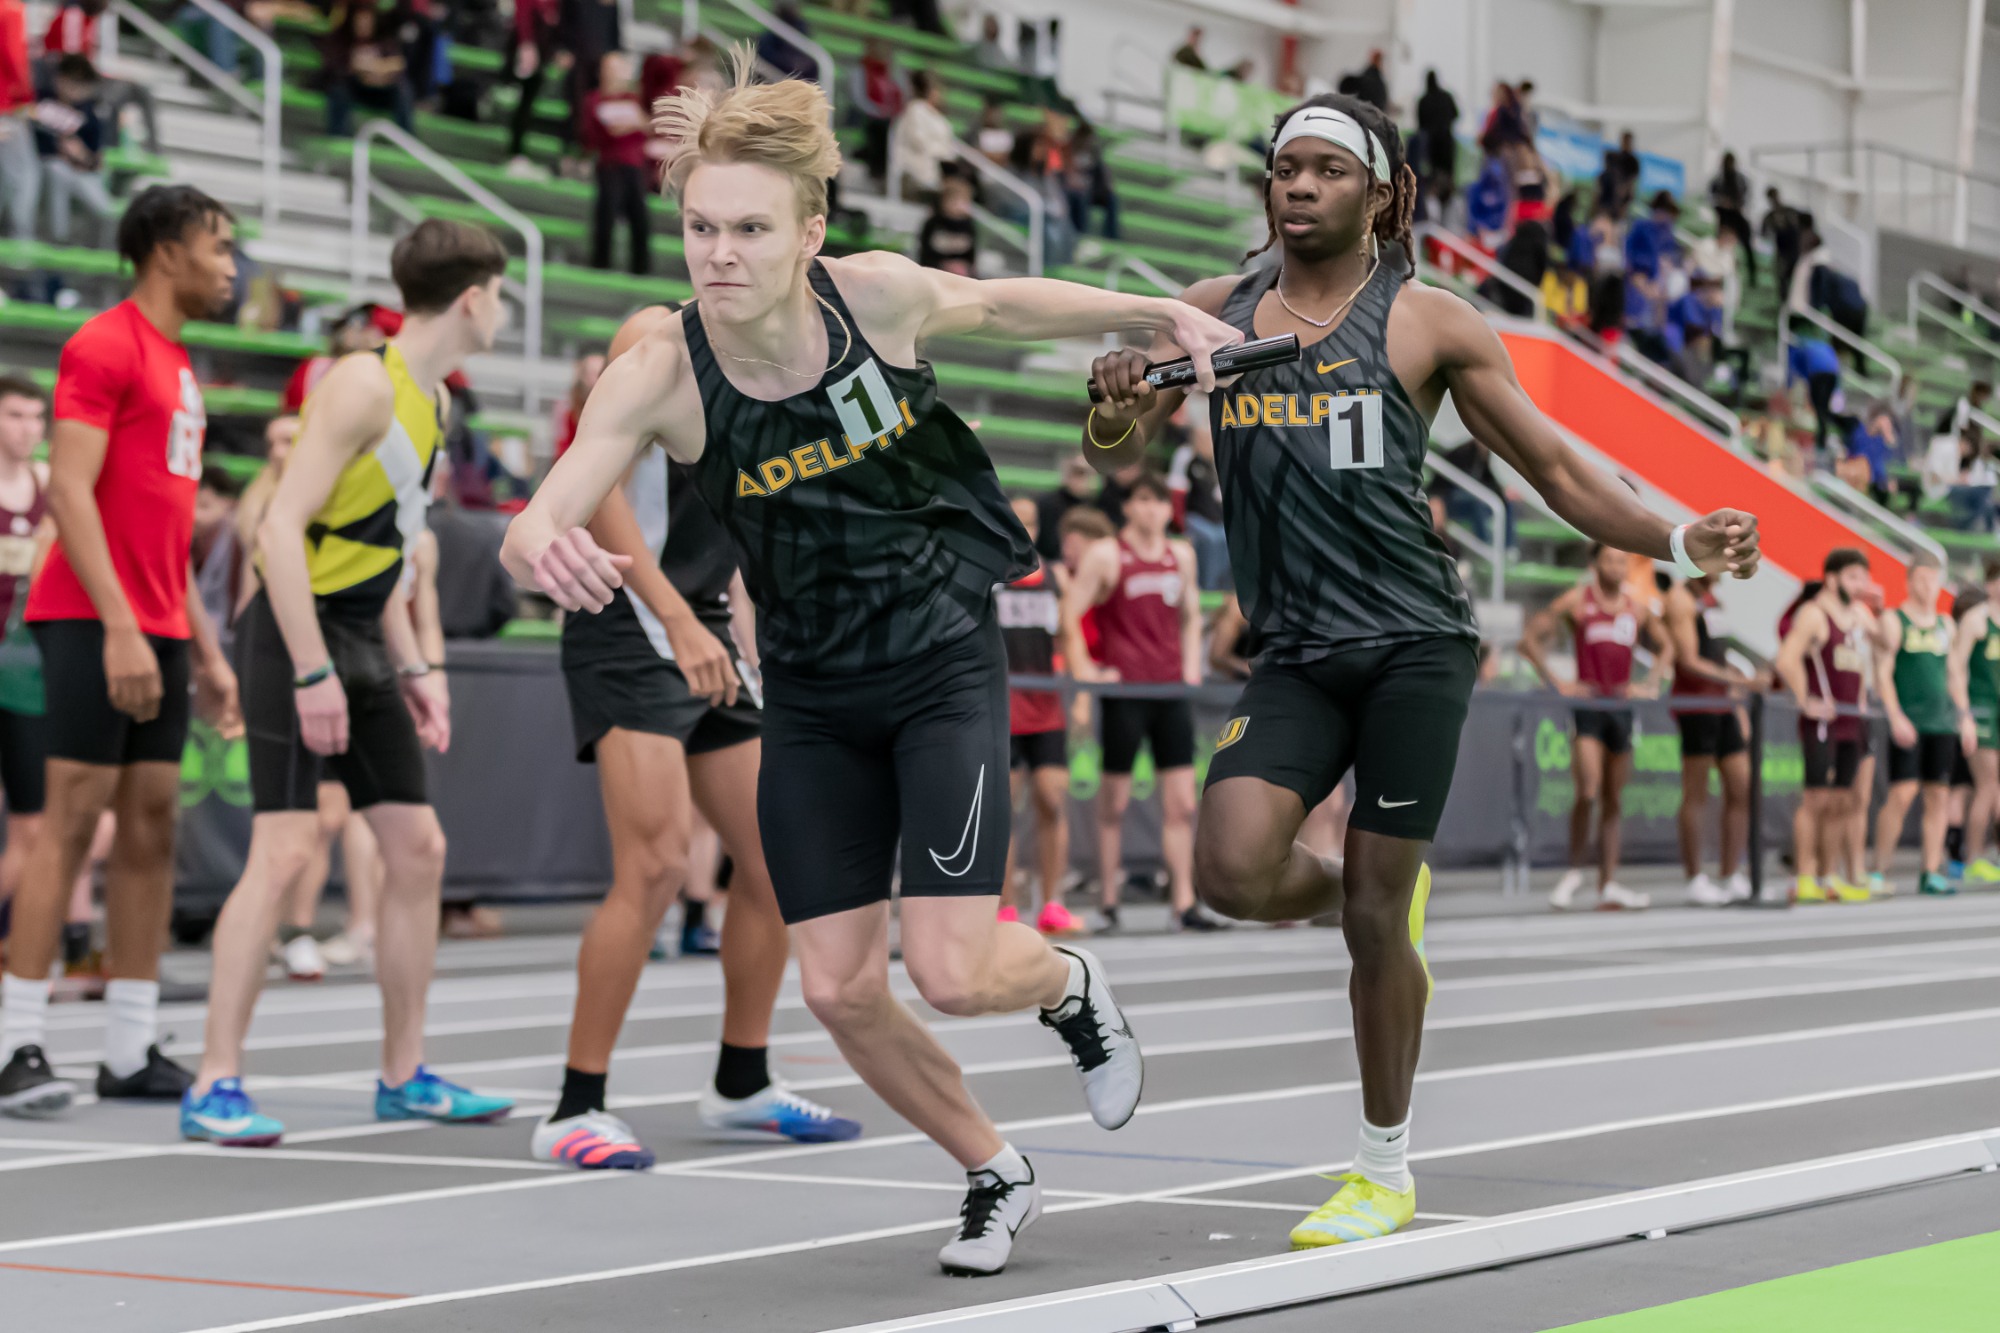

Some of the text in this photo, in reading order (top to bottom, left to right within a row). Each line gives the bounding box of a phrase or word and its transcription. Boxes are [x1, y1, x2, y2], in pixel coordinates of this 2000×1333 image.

[841, 375, 884, 435] 1
[1221, 387, 1382, 430] ADELP
[1338, 401, 1365, 464] 1
